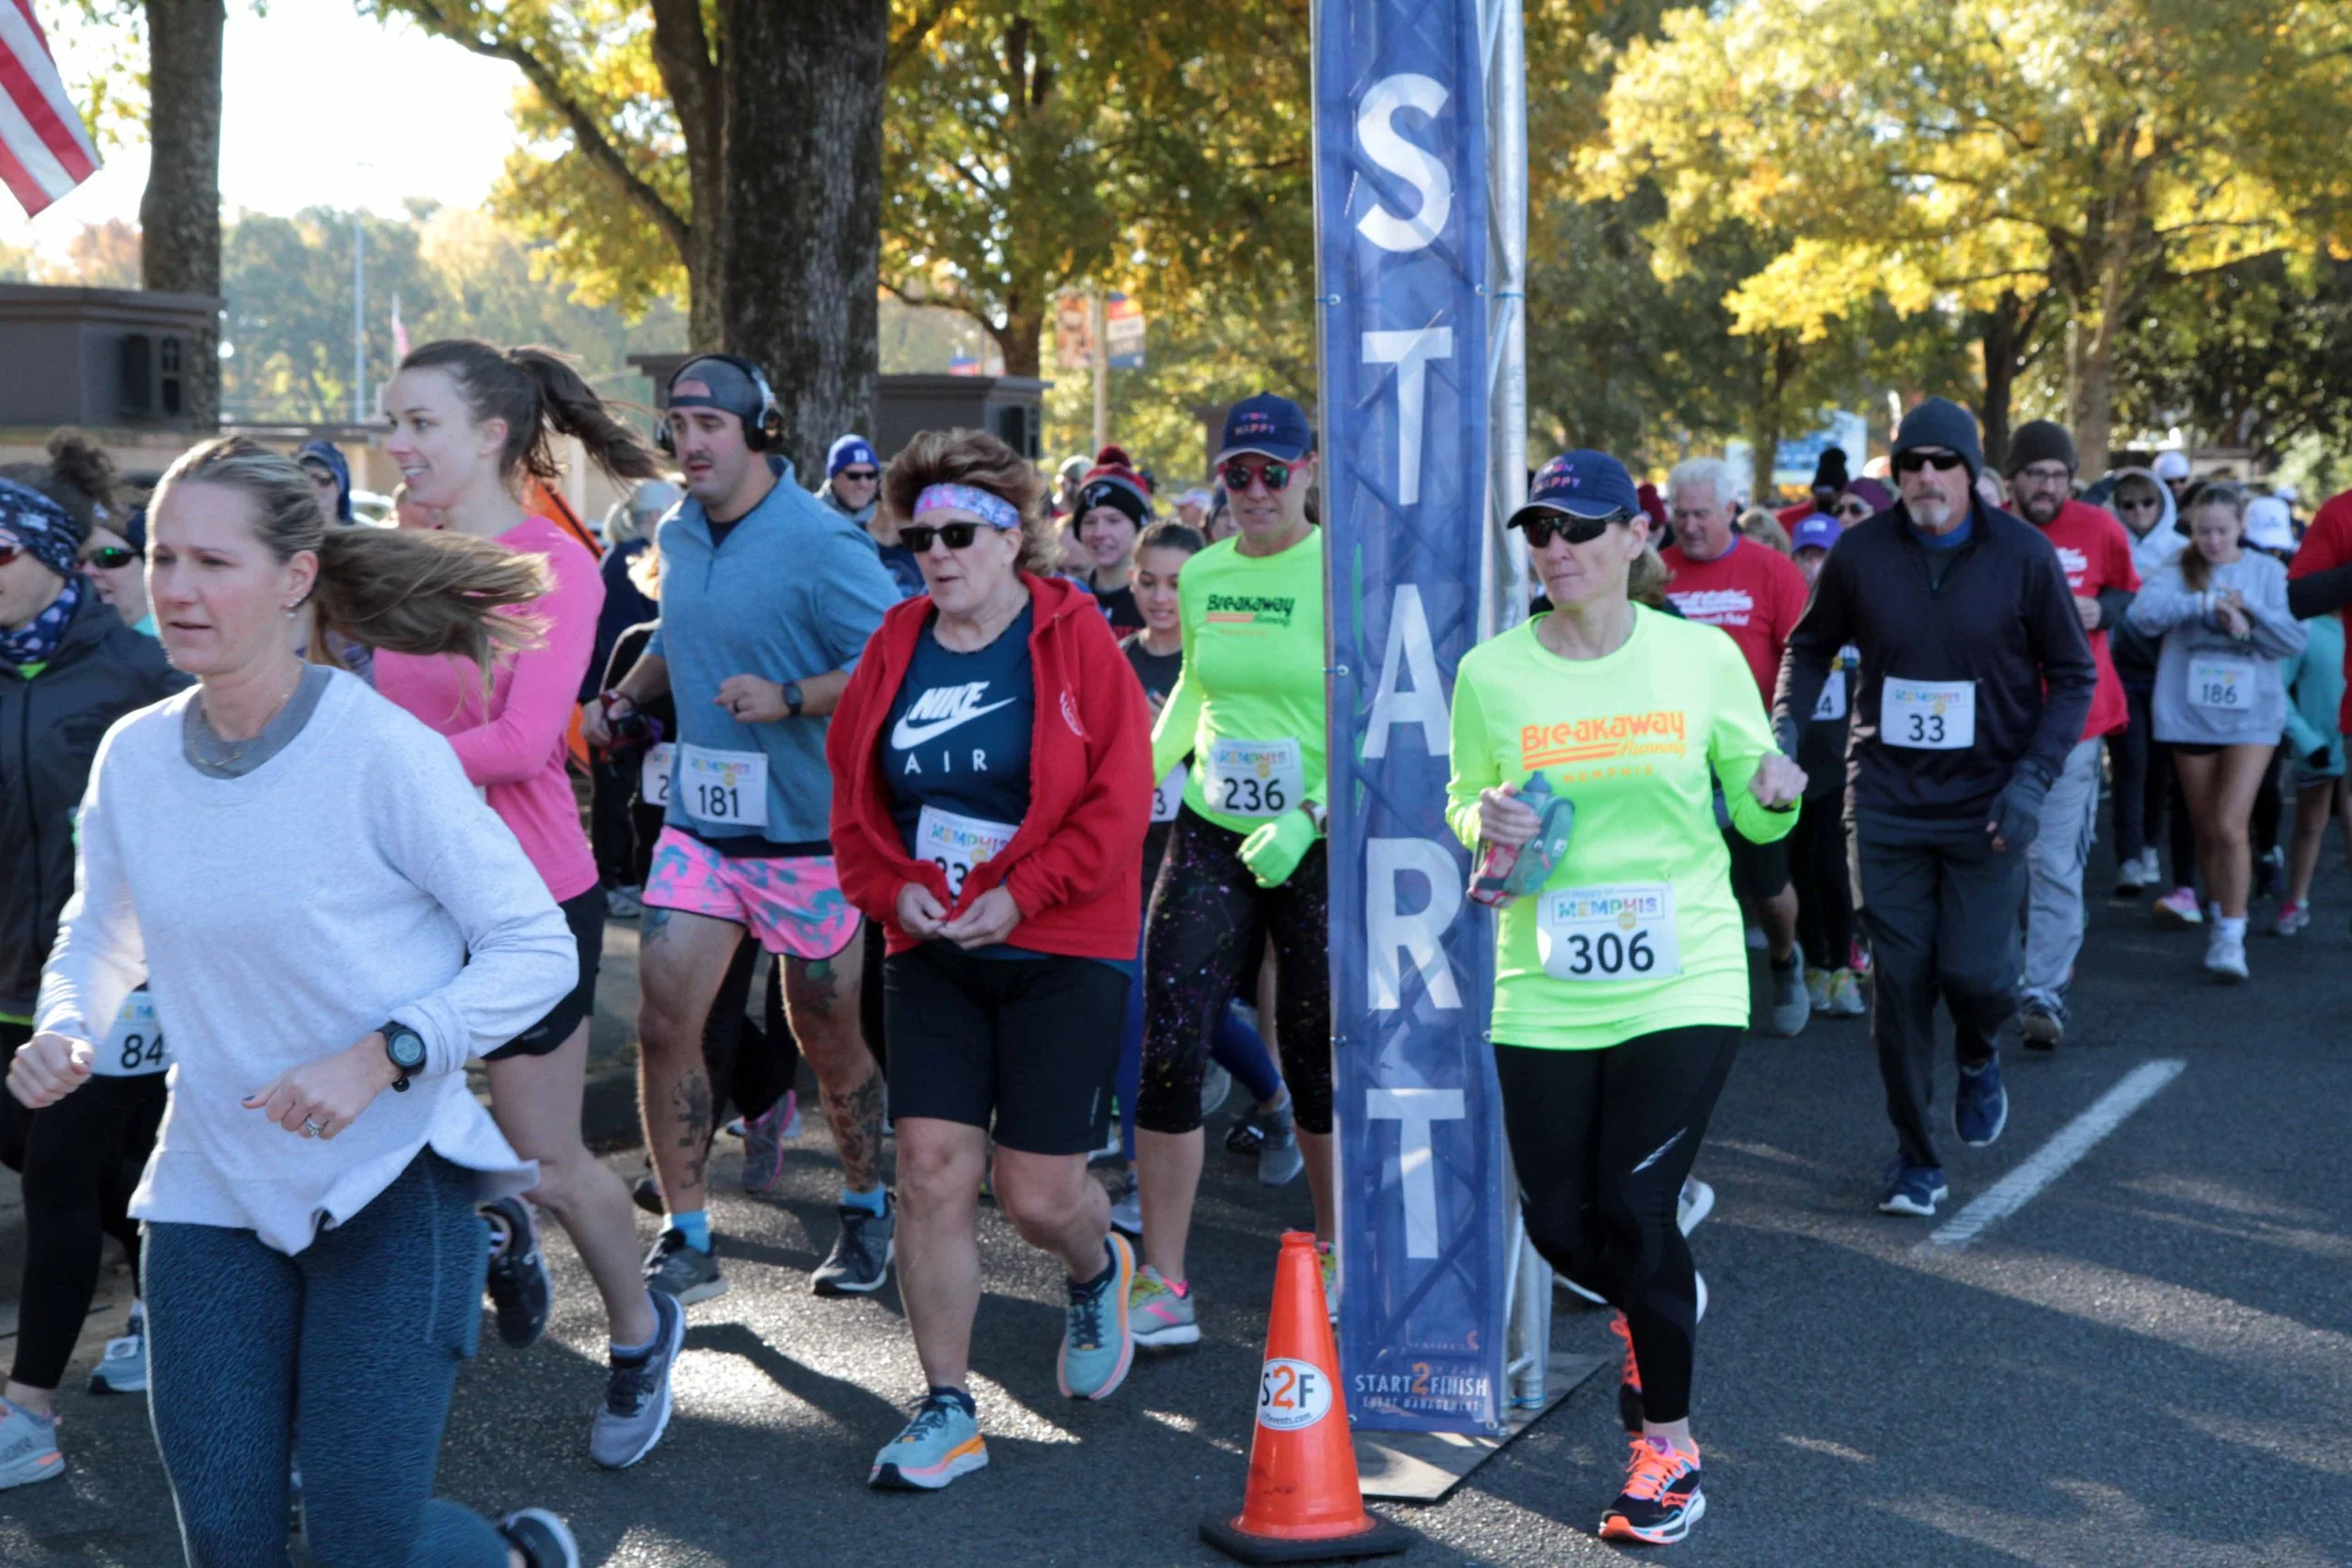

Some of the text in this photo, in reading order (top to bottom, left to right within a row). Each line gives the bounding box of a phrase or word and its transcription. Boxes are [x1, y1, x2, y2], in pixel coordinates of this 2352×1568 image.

[1357, 71, 1467, 1260] START
[908, 681, 990, 721] NIKE
[2202, 683, 2237, 705] 186
[1521, 711, 1684, 752] Breakaway
[1909, 715, 1945, 742] 33
[903, 749, 988, 775] AIR
[1563, 765, 1653, 783] MEMPHIS
[698, 784, 739, 817] 181
[1224, 778, 1285, 811] 236
[1558, 898, 1657, 917] MEMPHIS
[1567, 930, 1655, 974] 306
[121, 1033, 165, 1069] 84
[1261, 1366, 1314, 1410] S2F
